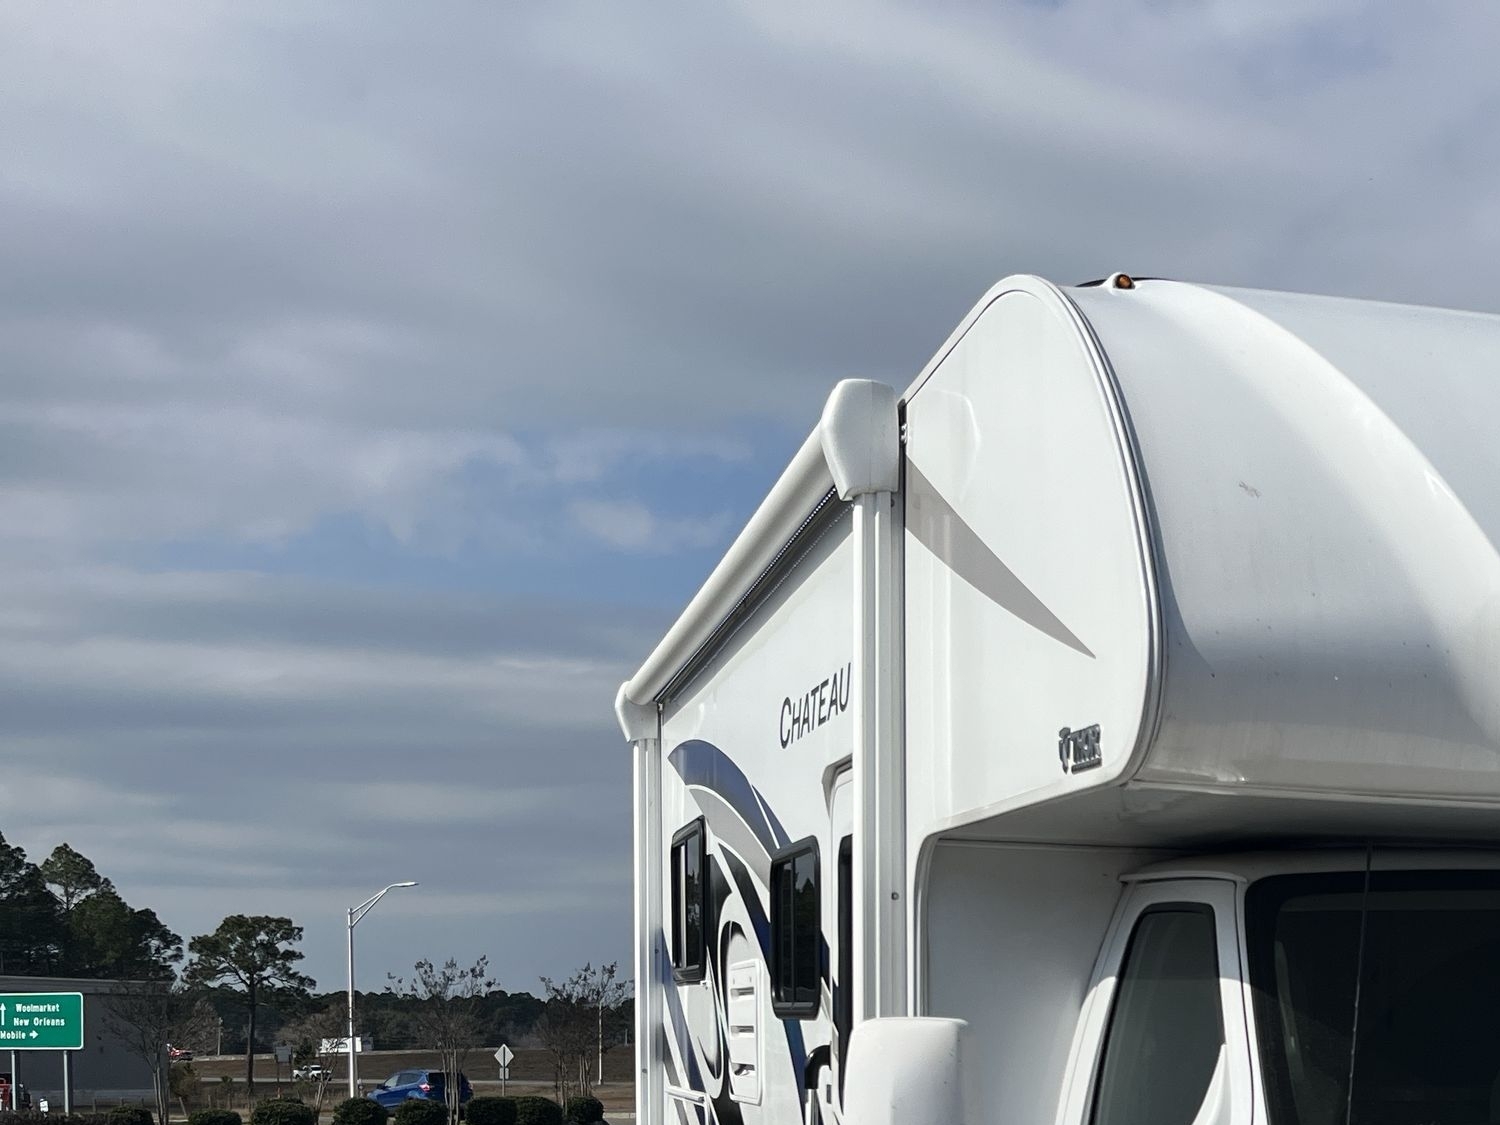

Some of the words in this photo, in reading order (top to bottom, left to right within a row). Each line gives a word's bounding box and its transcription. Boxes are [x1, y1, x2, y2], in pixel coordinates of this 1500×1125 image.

[780, 661, 851, 749] CHATEAU
[15, 1003, 60, 1012] Woolmarket
[13, 1017, 30, 1026] New
[33, 1017, 65, 1026] Orleans
[0, 1030, 26, 1040] Mobile
